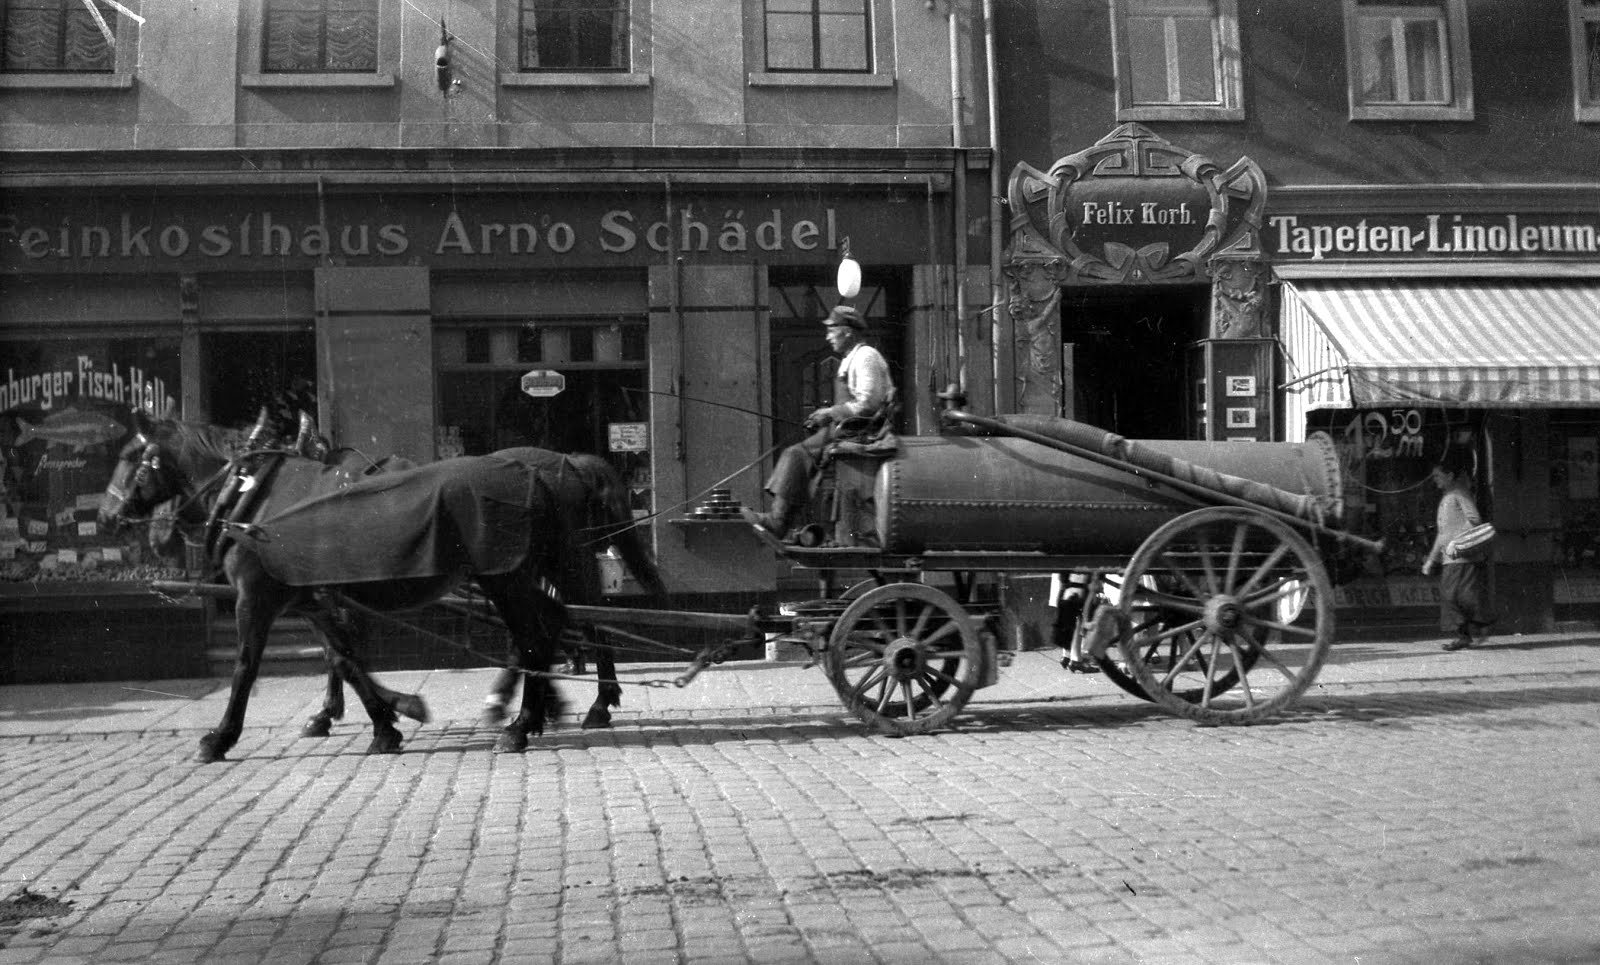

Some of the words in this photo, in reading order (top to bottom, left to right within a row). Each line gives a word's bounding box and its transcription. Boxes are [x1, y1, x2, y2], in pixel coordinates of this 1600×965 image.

[1082, 201, 1135, 225] Felix
[1140, 201, 1197, 225] Korb.
[435, 211, 576, 254] Arno
[598, 208, 838, 253] Schädel
